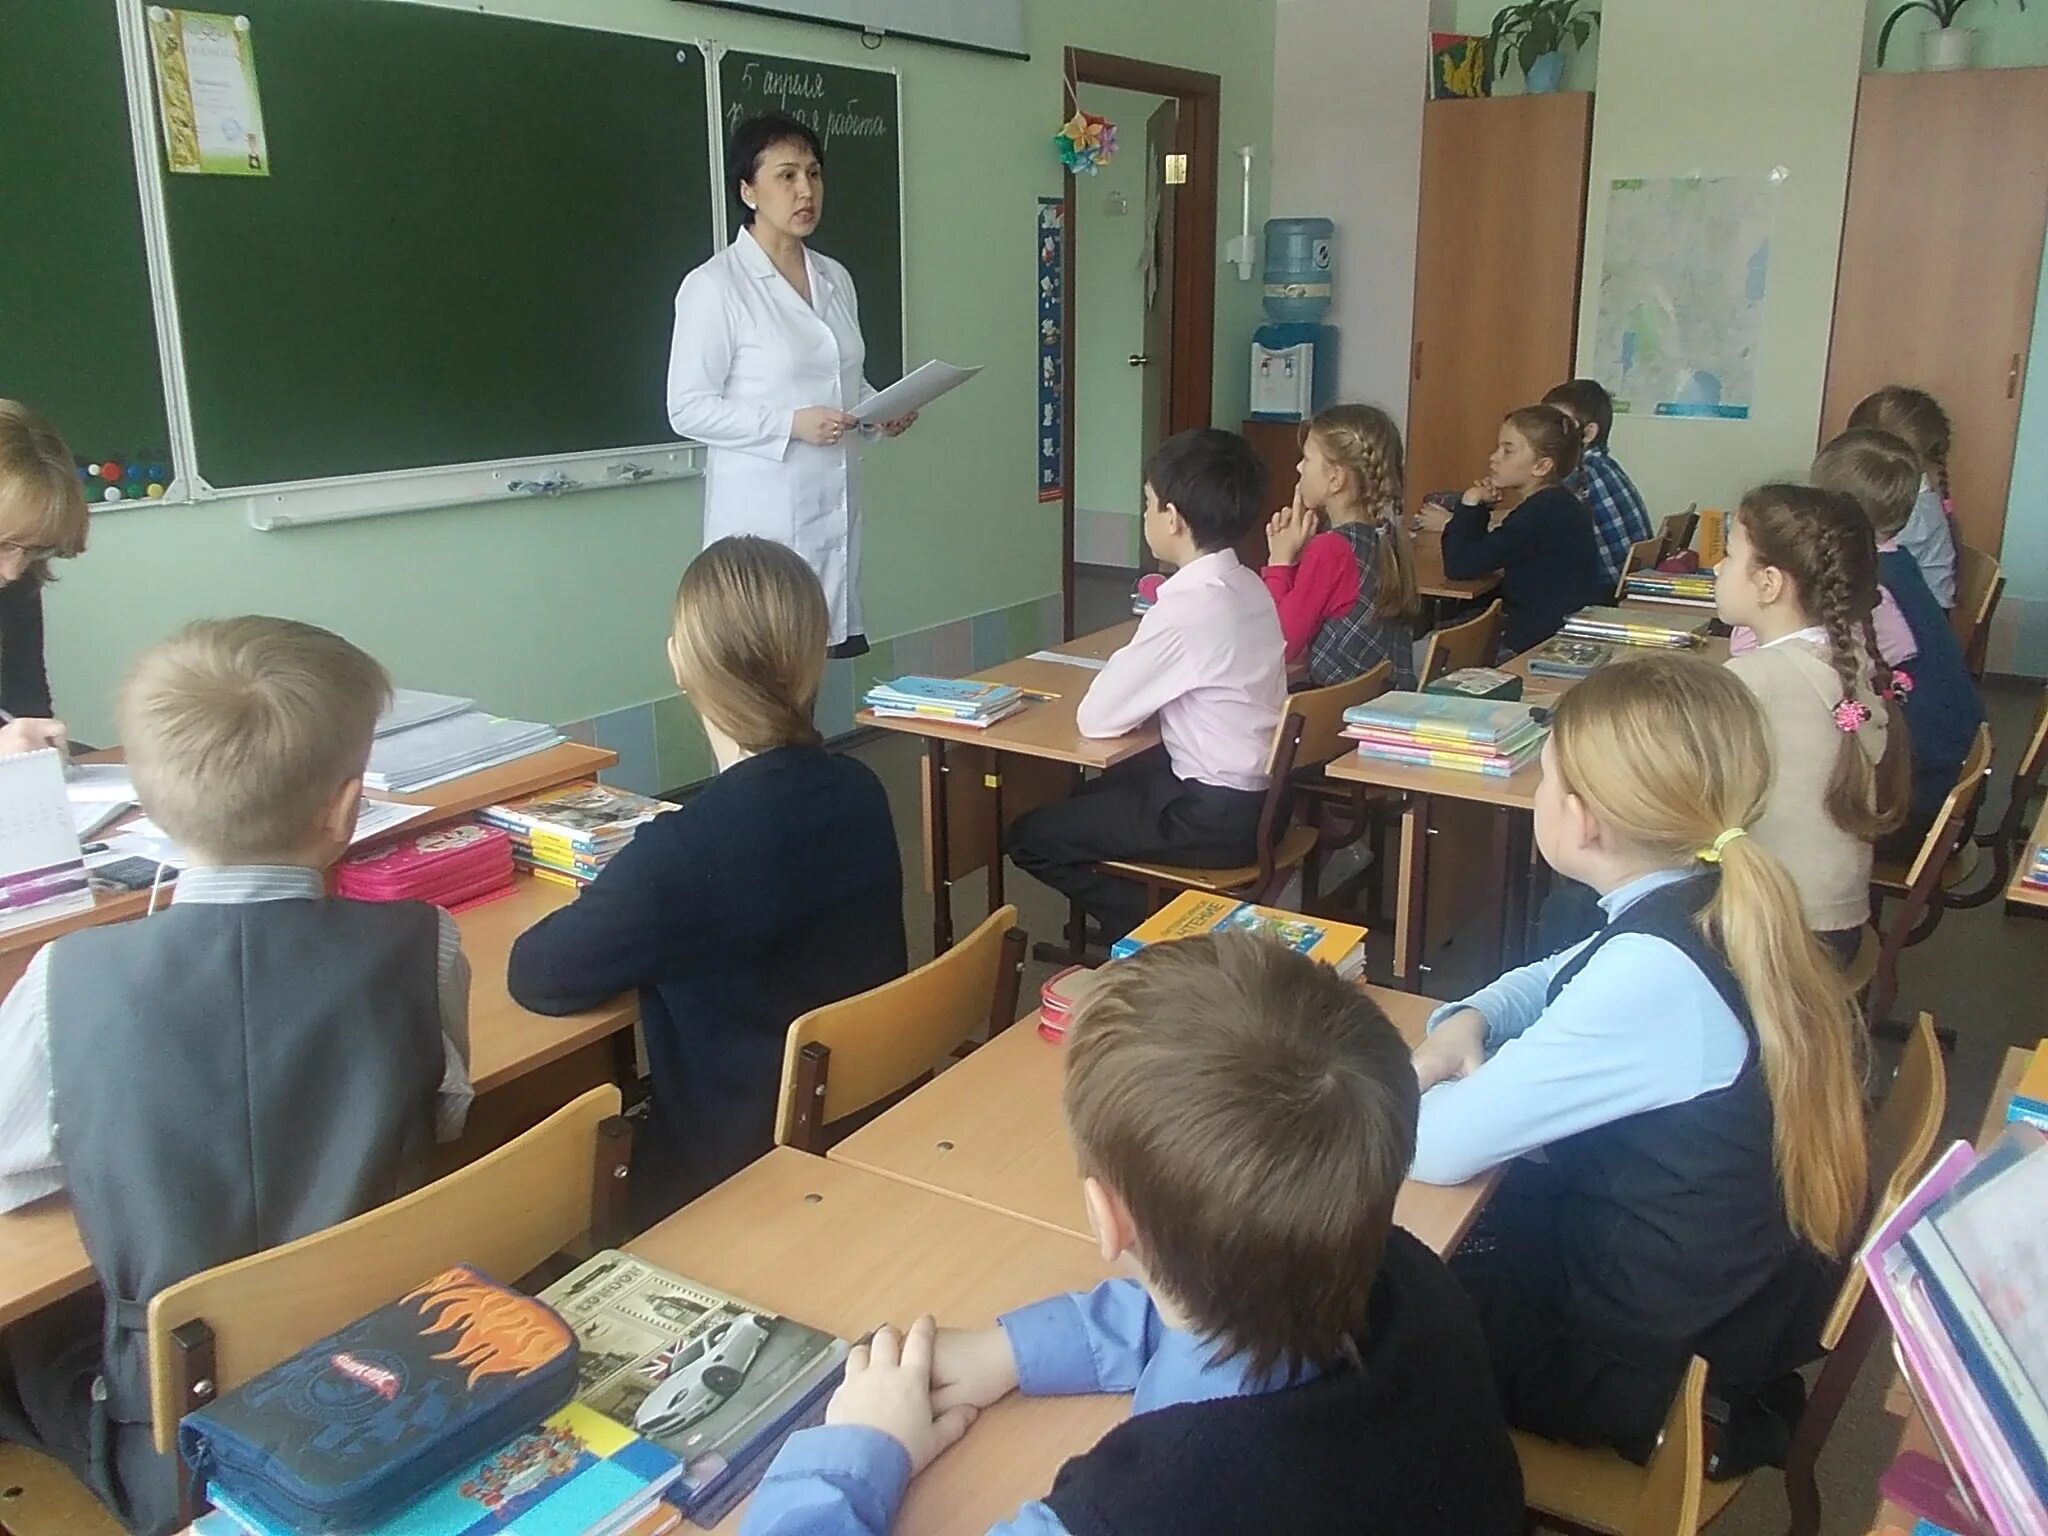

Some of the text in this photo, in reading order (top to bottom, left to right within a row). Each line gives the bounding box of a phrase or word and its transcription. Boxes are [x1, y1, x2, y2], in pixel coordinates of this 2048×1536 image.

[741, 62, 825, 111] 5 апреля
[823, 98, 887, 151] работа
[575, 1265, 642, 1311] LONDON
